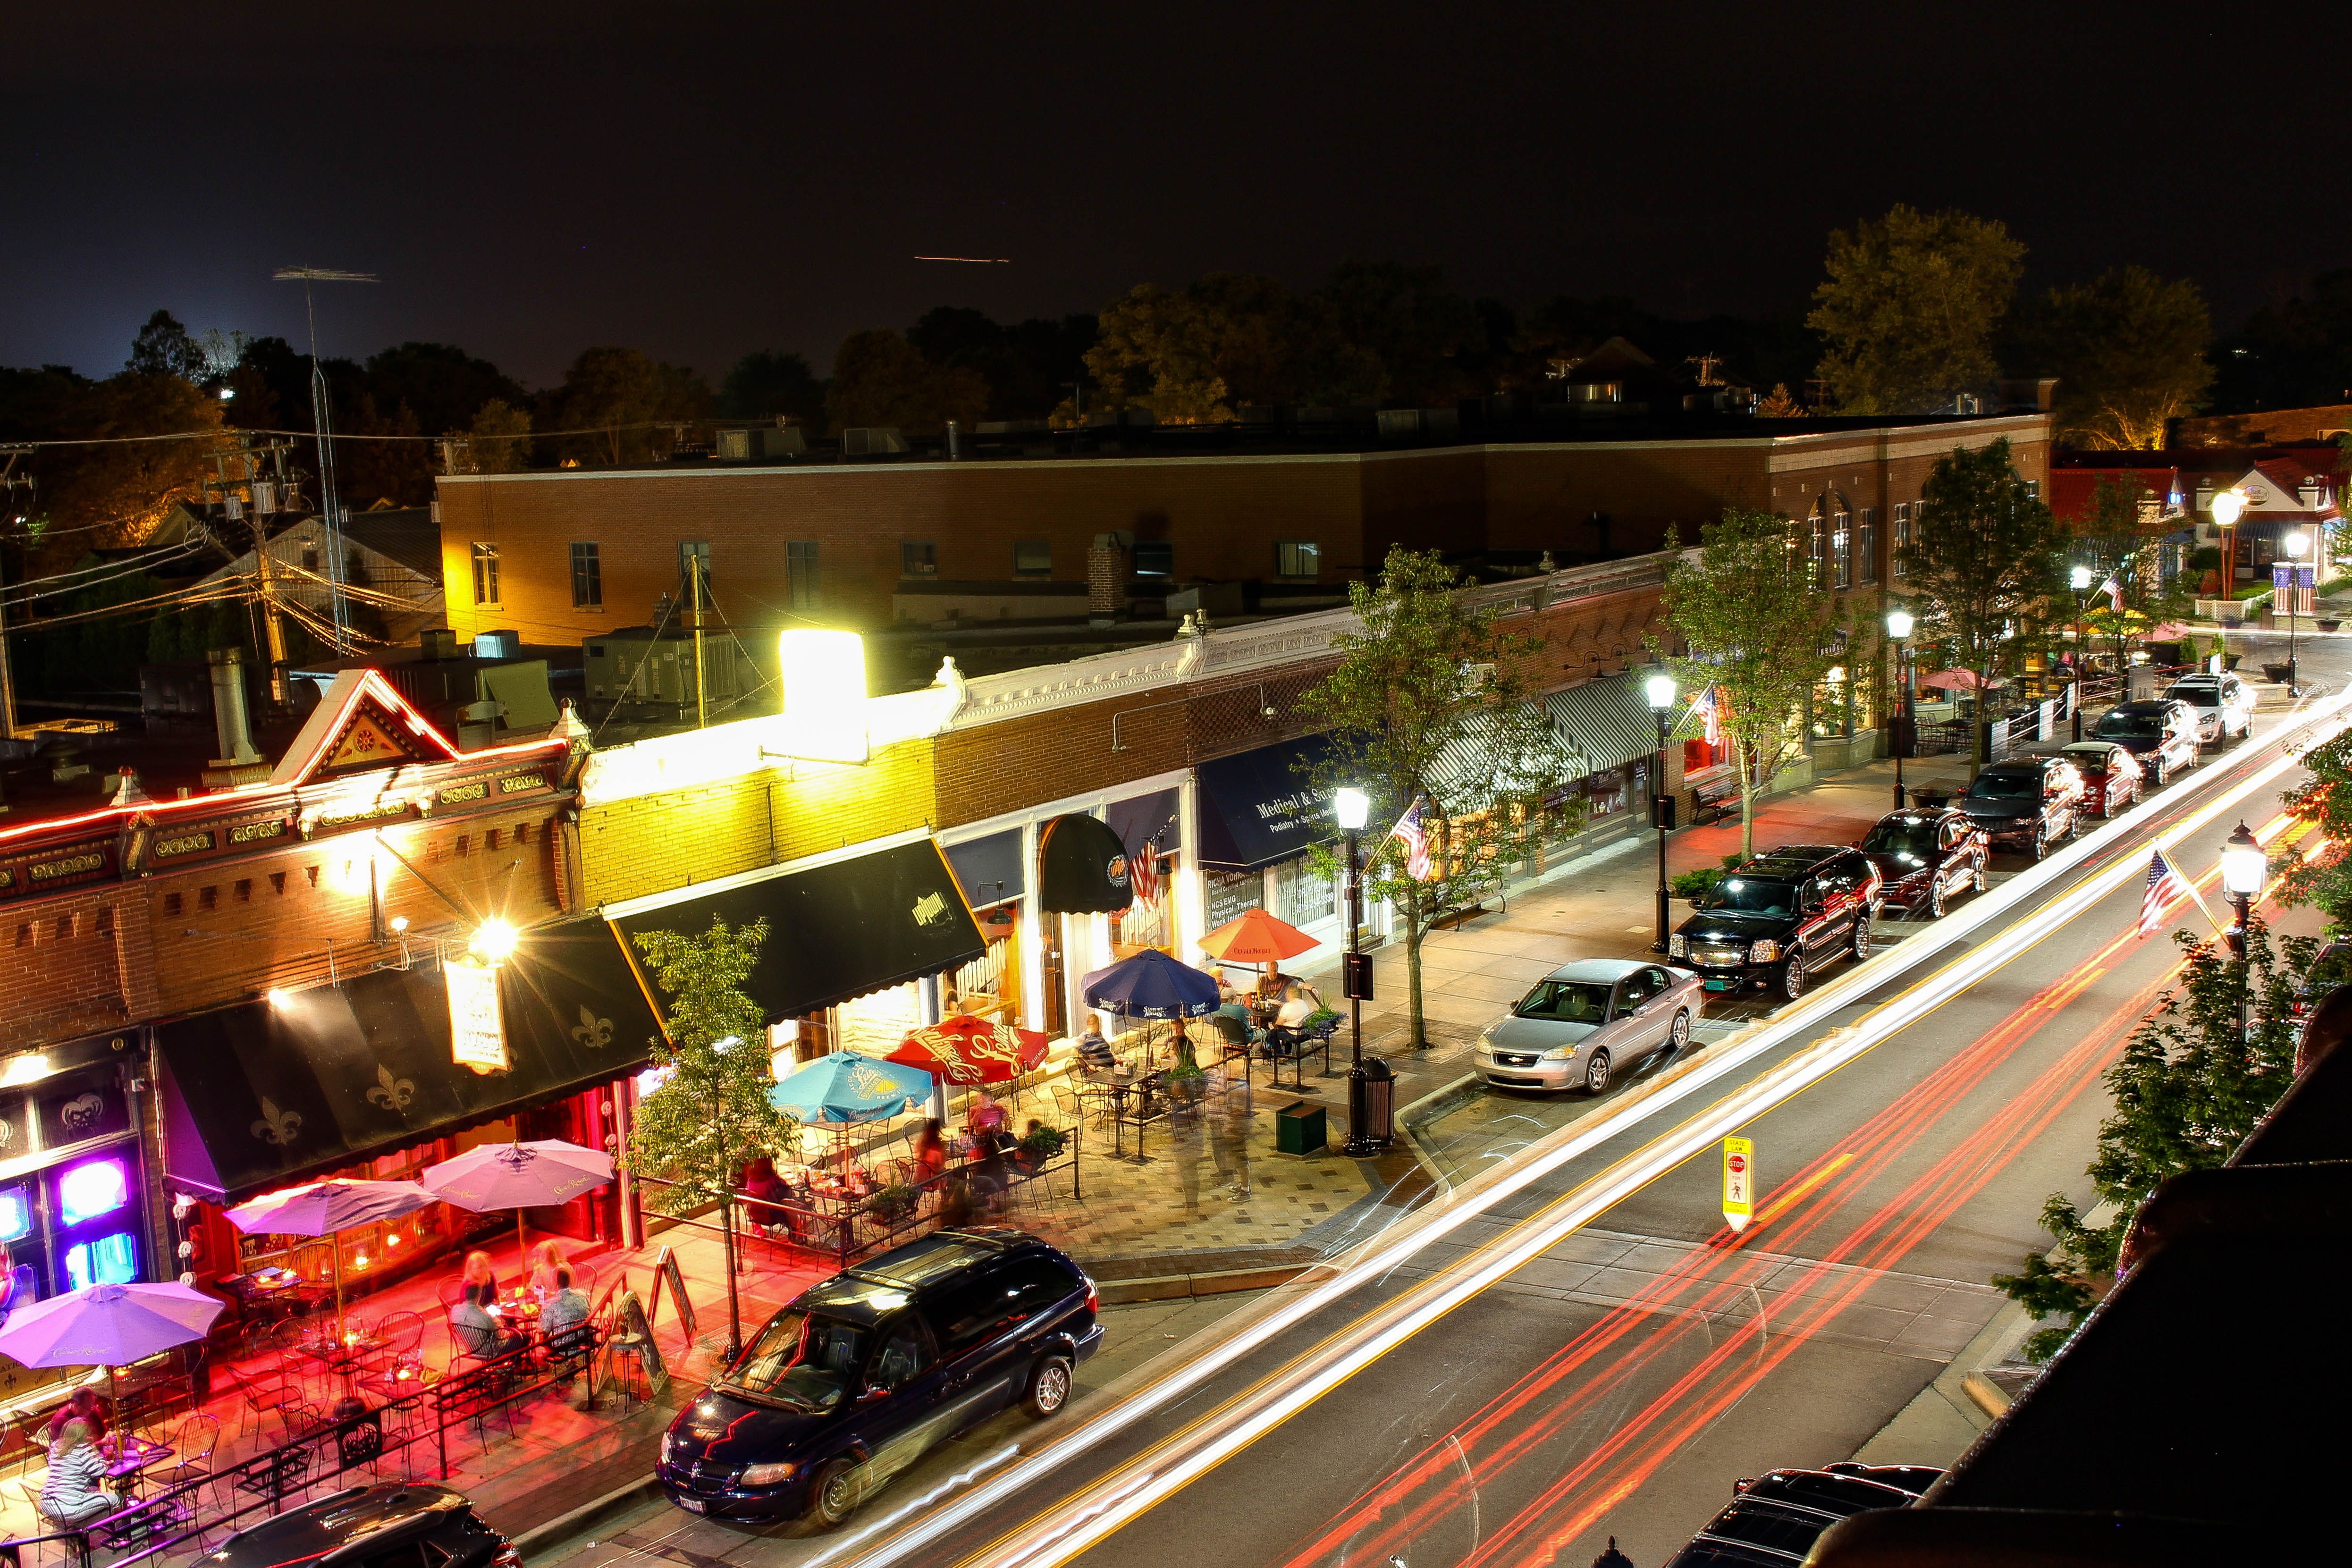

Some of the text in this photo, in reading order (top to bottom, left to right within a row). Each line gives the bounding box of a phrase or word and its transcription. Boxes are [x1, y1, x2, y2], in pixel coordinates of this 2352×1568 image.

[1255, 794, 1299, 819] Medical
[1301, 791, 1311, 806] &
[1269, 806, 1337, 834] Podiatry Sports Medic
[1207, 876, 1225, 889] RICHA
[1211, 885, 1222, 896] Board
[1222, 882, 1239, 893] Certified
[912, 891, 944, 926] UPTOWN
[1211, 894, 1236, 910] NCS/EMG
[1211, 897, 1259, 919] Physical Therapy
[1211, 910, 1247, 928] Work Injurie
[955, 936, 1006, 1005] UPTOWN
[986, 974, 1002, 995] eatery
[1729, 1160, 1745, 1168] STOP
[553, 1174, 590, 1195] Crown Royal
